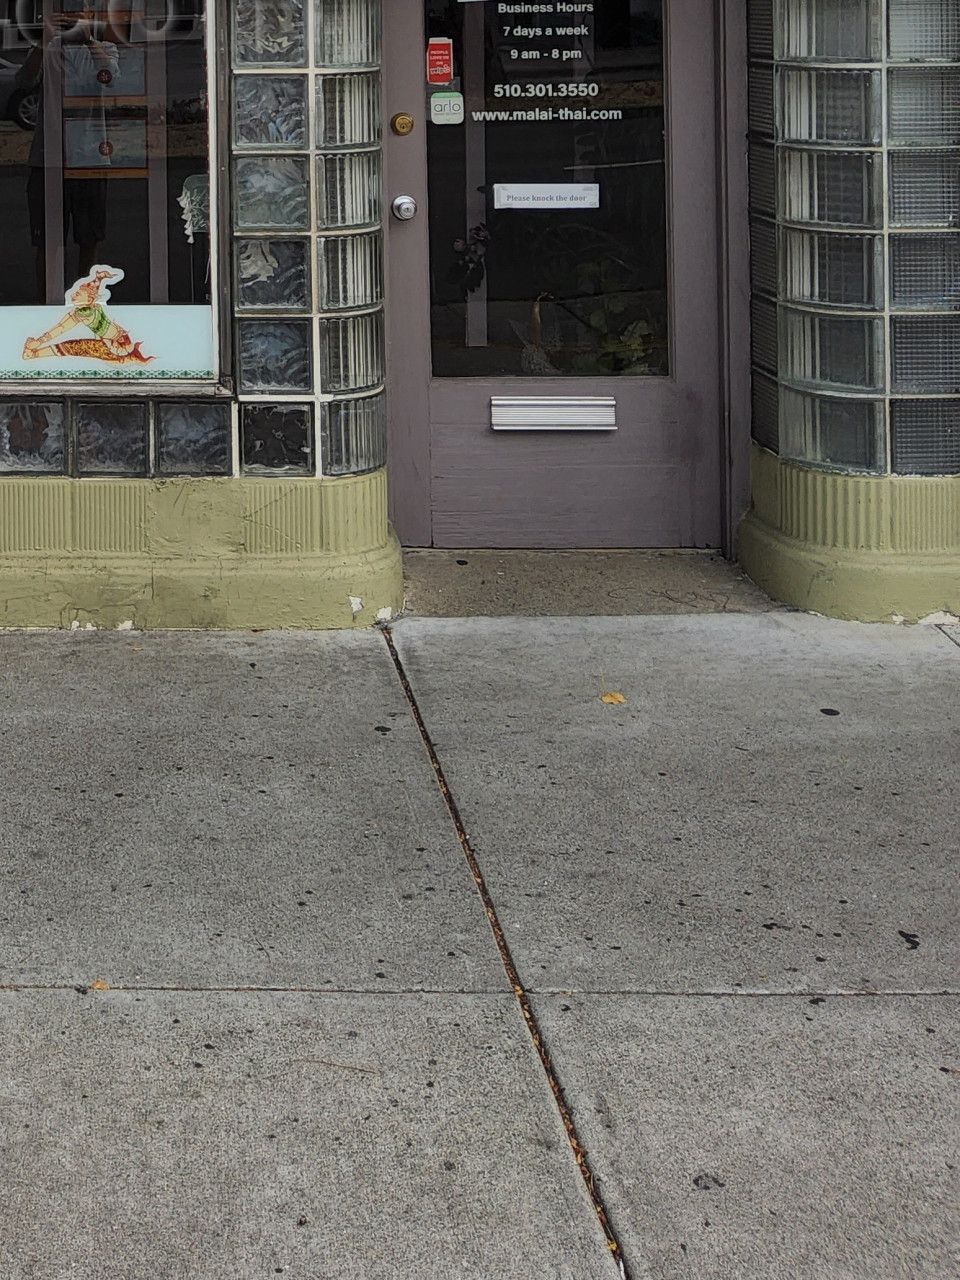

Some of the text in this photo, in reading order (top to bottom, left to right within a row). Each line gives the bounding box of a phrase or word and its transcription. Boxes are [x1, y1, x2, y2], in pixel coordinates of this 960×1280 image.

[498, 1, 594, 14] Business Hours
[503, 25, 589, 38] 7 days a week
[510, 49, 518, 59] 9
[521, 51, 540, 59] am
[551, 49, 560, 59] 8
[562, 51, 582, 61] pm
[493, 83, 599, 98] 510.301.3550
[434, 99, 462, 113] arlo
[472, 107, 623, 121] www.malai-thai.com
[506, 194, 587, 202] Please knock the door
